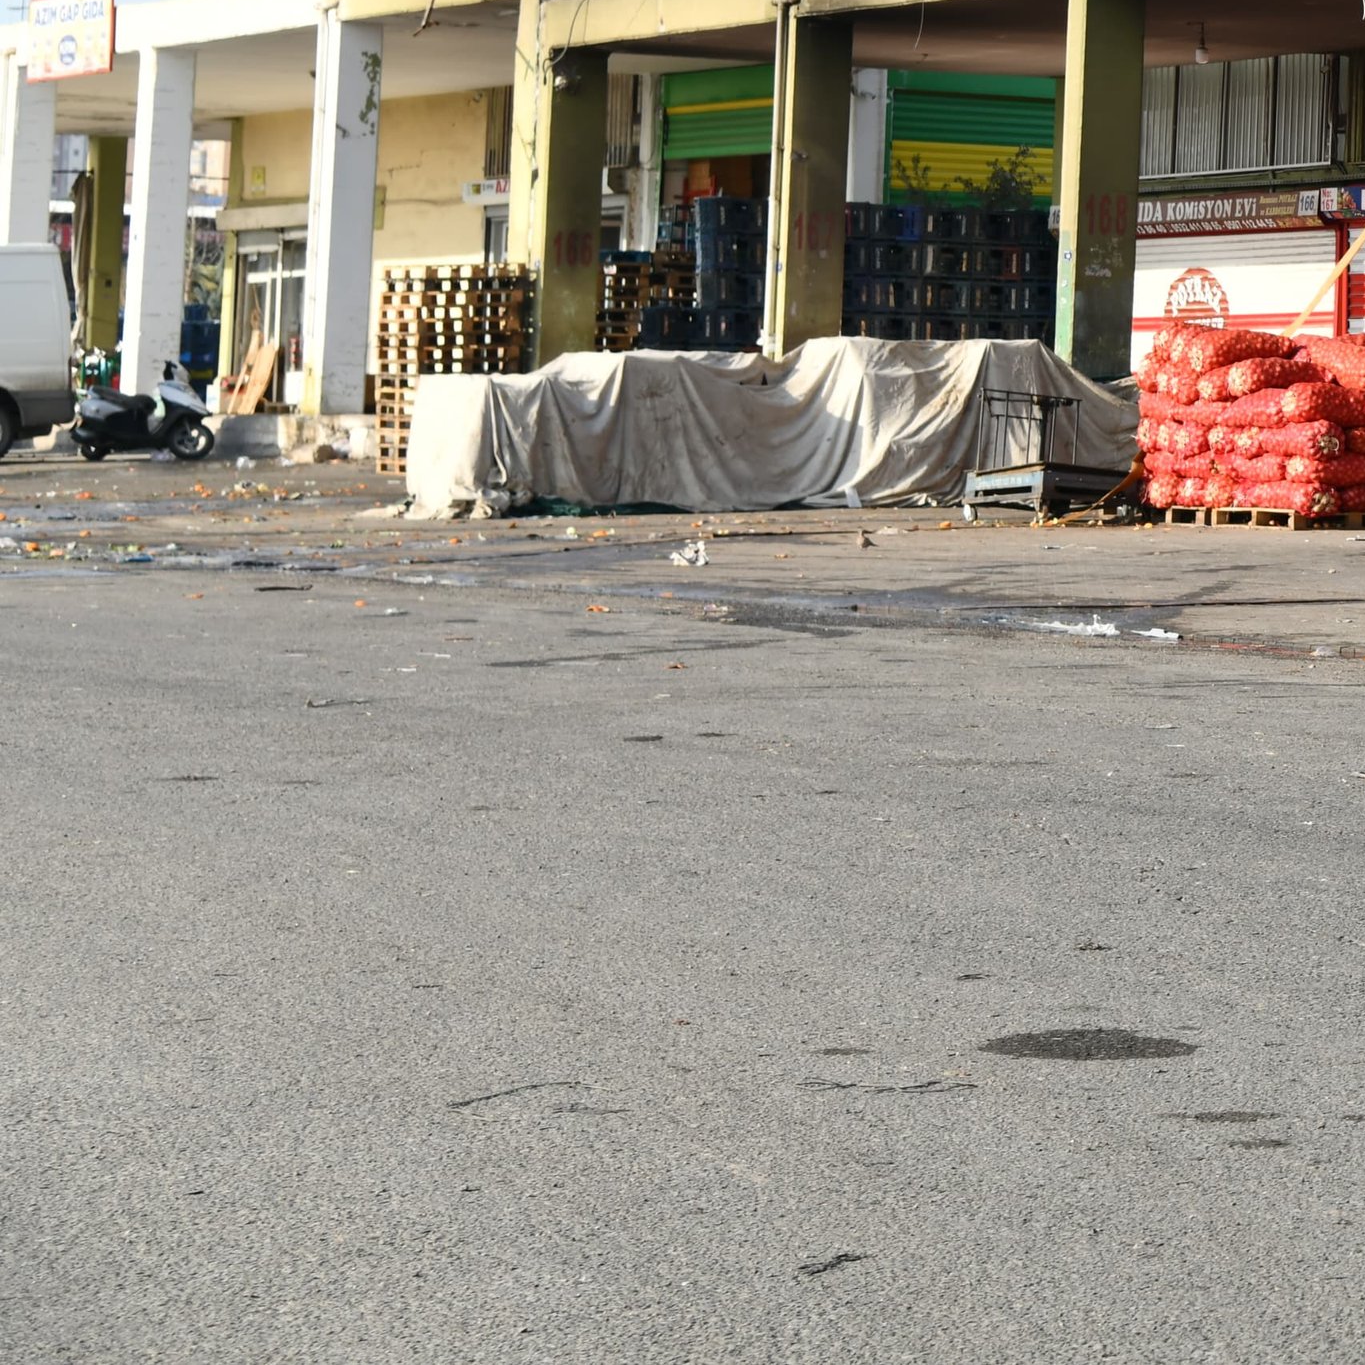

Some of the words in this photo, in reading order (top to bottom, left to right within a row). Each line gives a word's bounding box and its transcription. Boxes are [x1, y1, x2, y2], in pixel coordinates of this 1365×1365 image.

[1300, 195, 1315, 212] 166
[1321, 188, 1332, 198] No:
[1321, 199, 1334, 211] 167
[1085, 193, 1127, 235] 168
[794, 212, 833, 251] 167
[553, 229, 594, 268] 166
